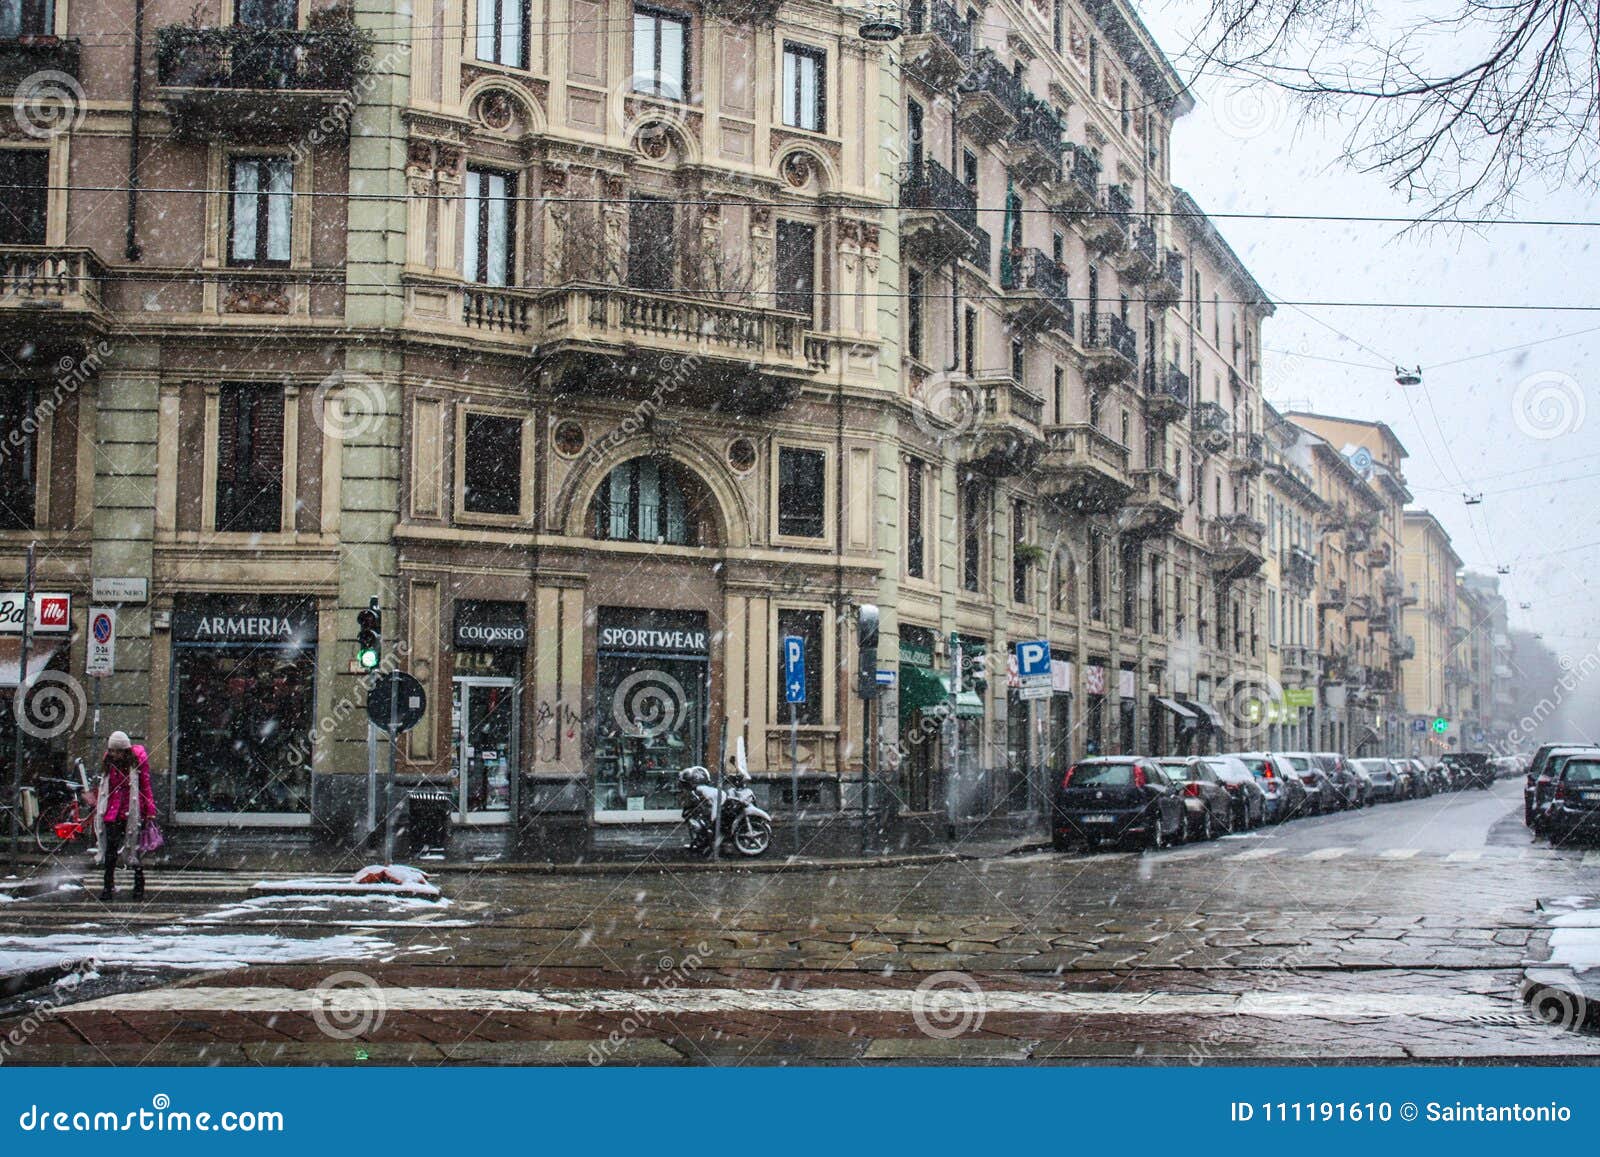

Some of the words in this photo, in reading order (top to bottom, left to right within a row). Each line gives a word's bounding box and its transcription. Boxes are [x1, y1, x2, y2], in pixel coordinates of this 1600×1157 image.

[0, 601, 37, 623] Ba
[43, 600, 65, 622] illy
[197, 616, 293, 635] ARMERIA
[460, 626, 524, 640] COLOSSEO
[603, 628, 705, 649] SPORTWEAR
[789, 641, 800, 673] P
[1022, 644, 1043, 673] P
